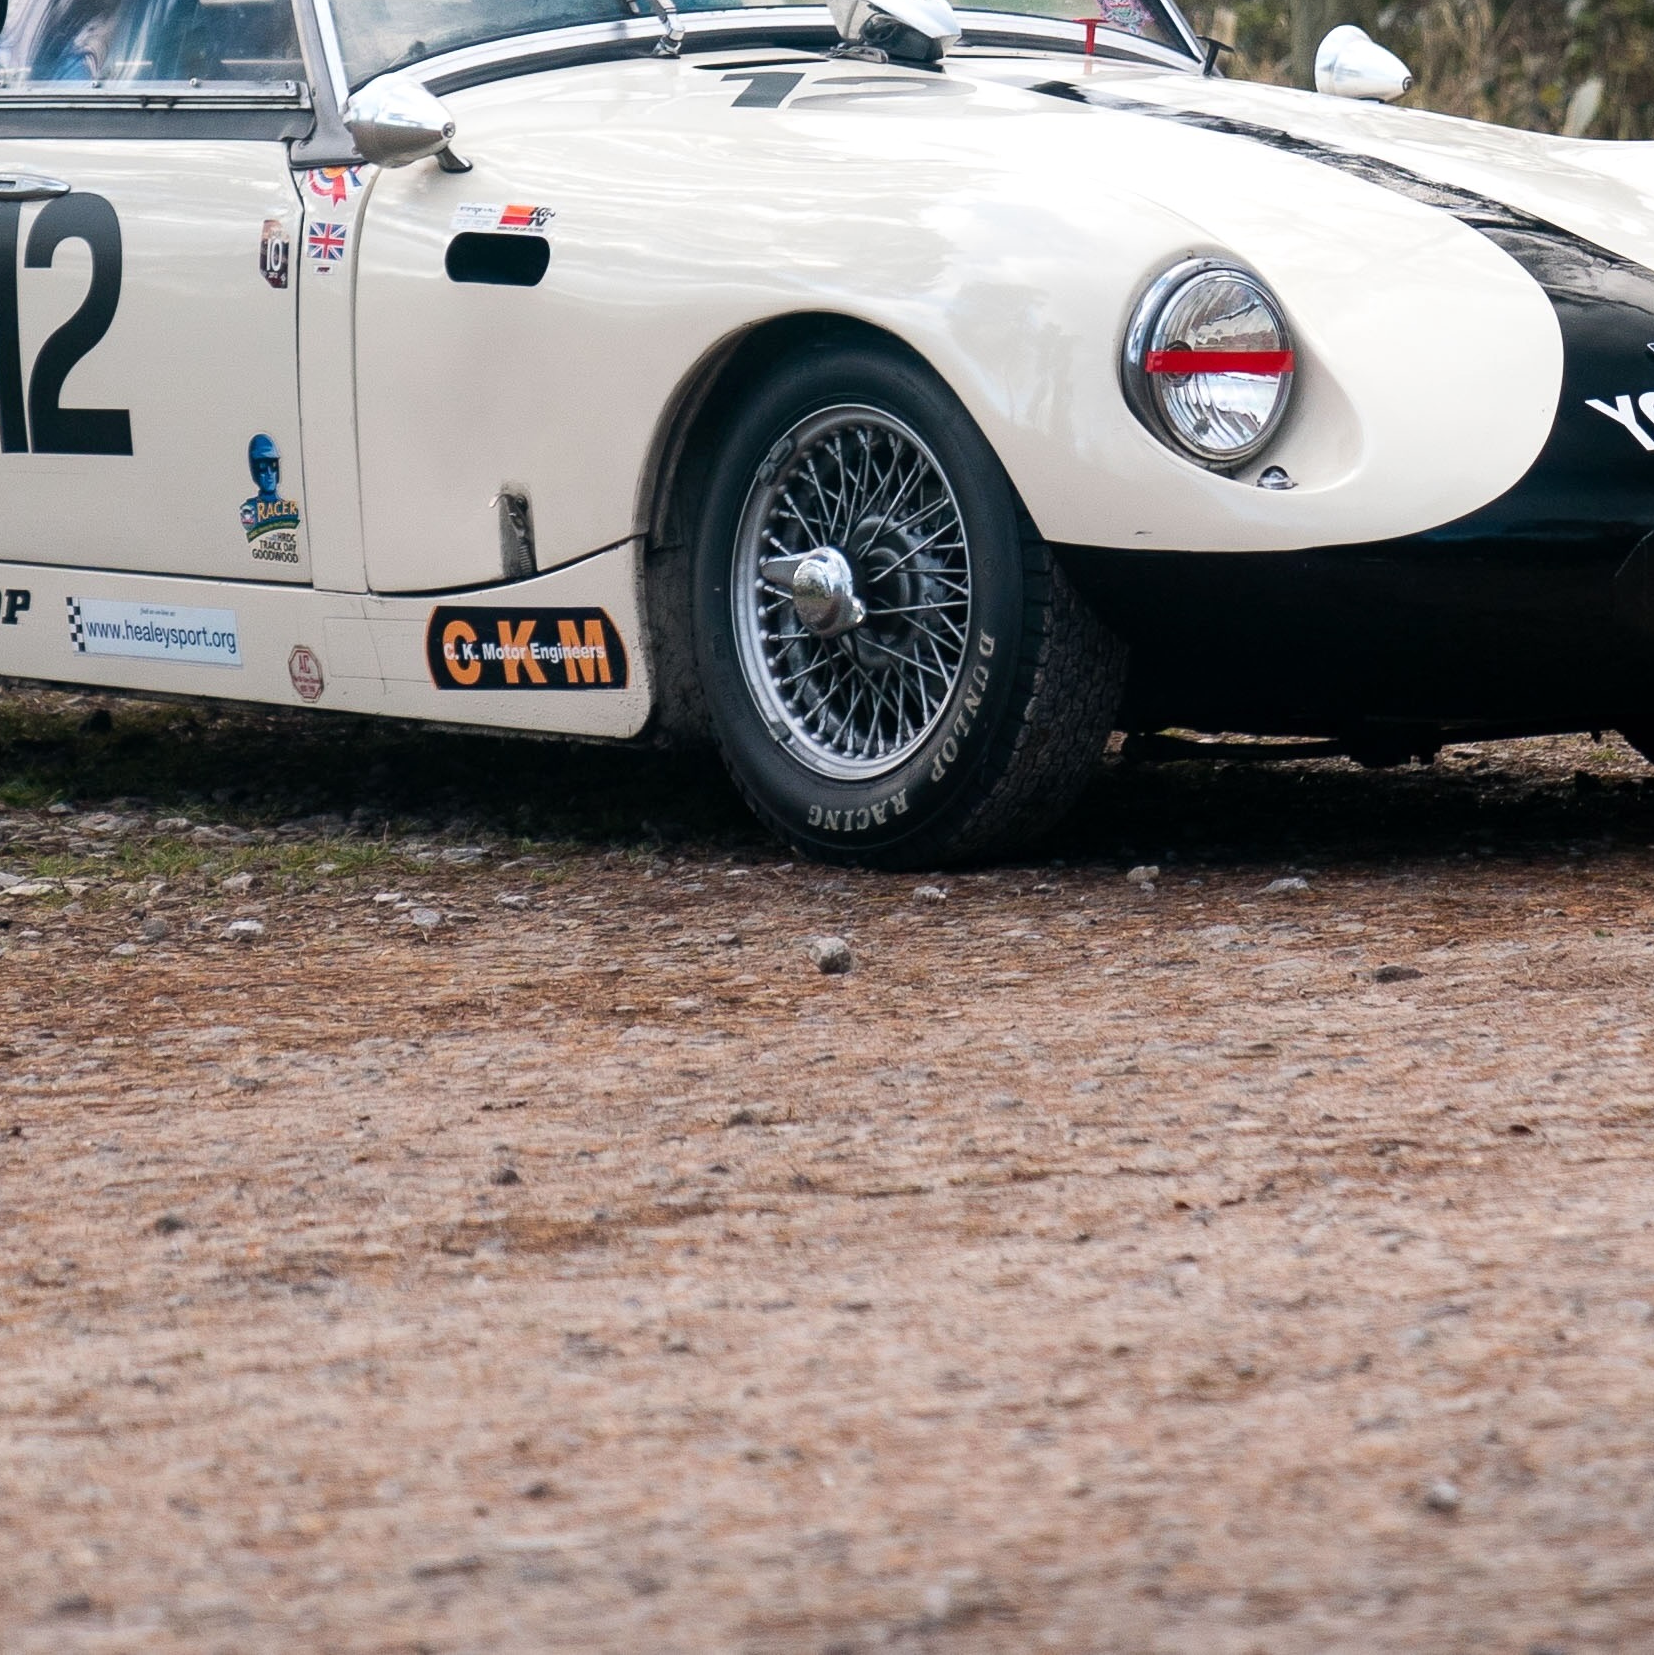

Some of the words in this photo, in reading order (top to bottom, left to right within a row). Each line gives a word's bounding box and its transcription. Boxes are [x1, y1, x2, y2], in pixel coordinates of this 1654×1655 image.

[257, 499, 298, 523] RACER
[252, 548, 299, 564] GOODWOOD
[259, 539, 283, 552] TRACK
[283, 542, 297, 554] DAY
[86, 619, 237, 655] www.healeysport.org
[444, 643, 460, 661] C.
[463, 643, 480, 661] K.
[481, 642, 527, 661] Motor
[529, 642, 606, 665] Engineers
[931, 628, 995, 783] DUNLOP
[807, 788, 910, 833] RACING
